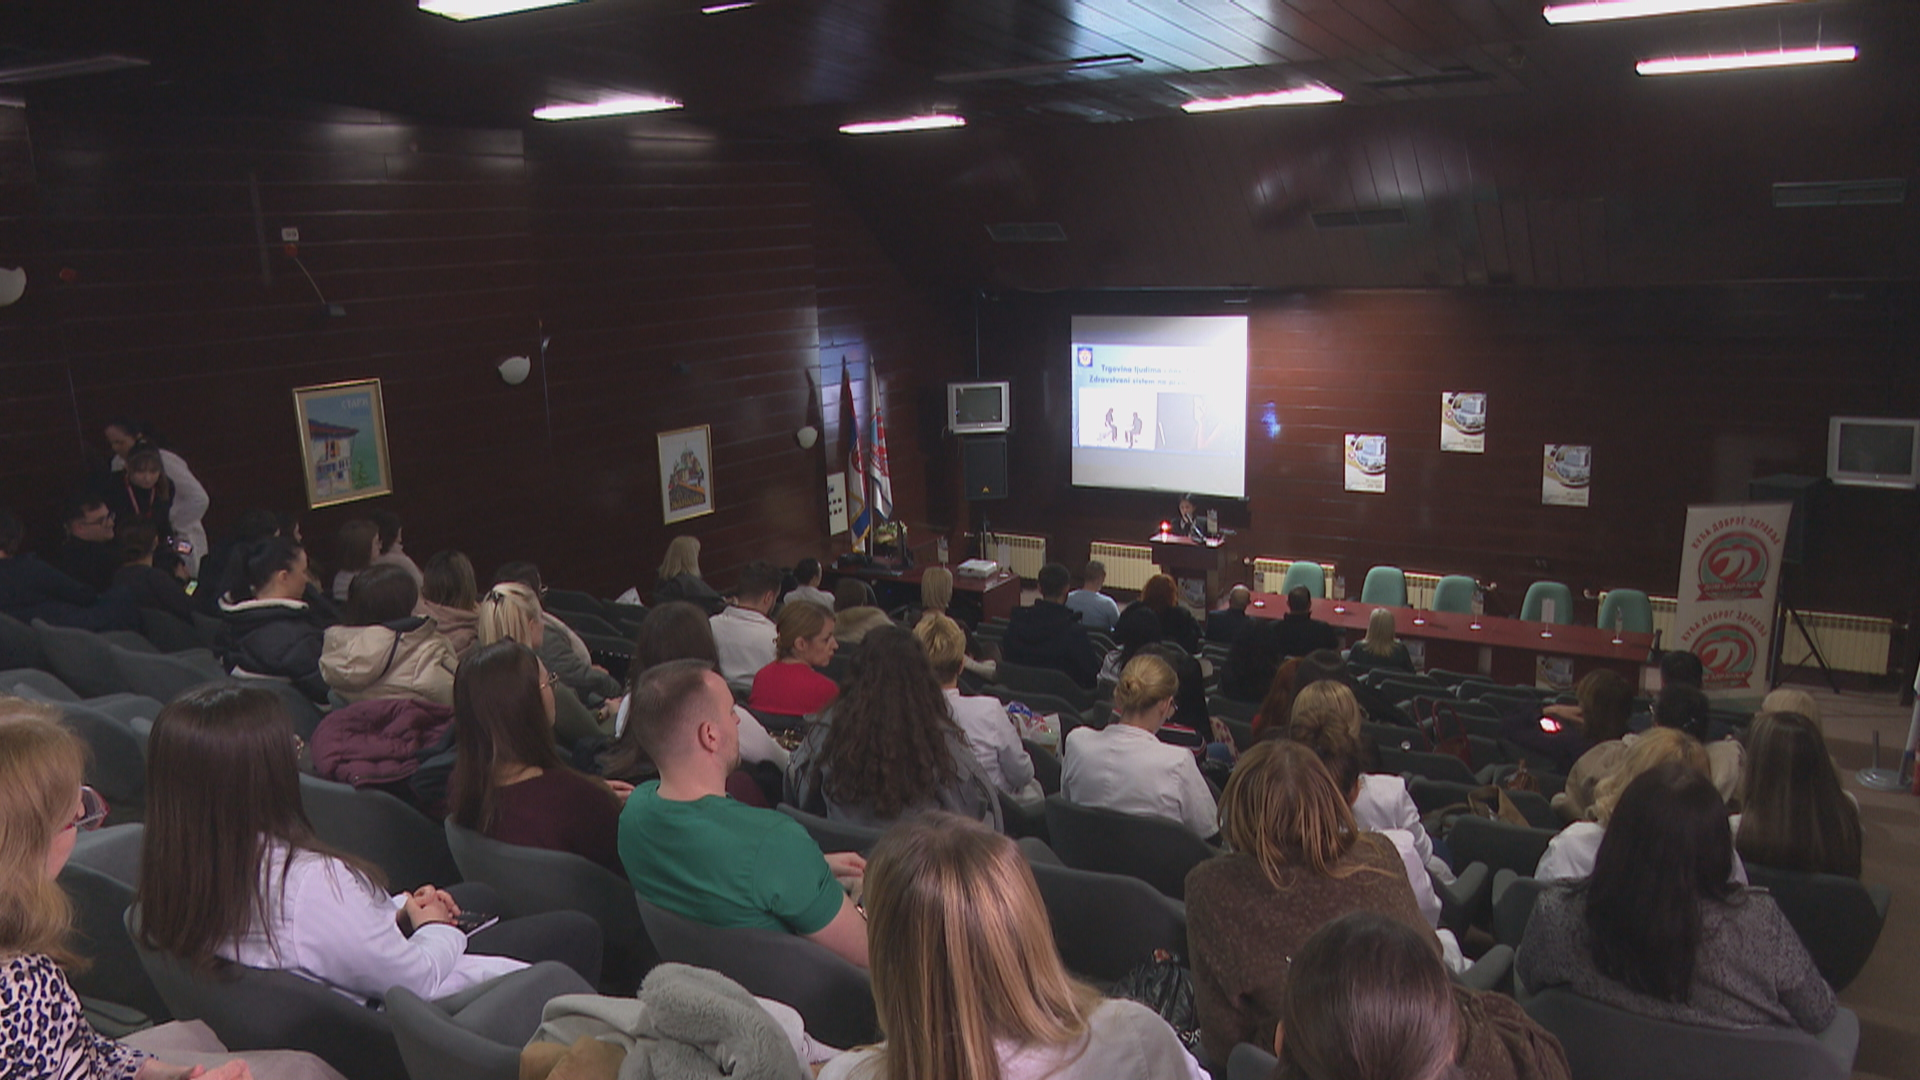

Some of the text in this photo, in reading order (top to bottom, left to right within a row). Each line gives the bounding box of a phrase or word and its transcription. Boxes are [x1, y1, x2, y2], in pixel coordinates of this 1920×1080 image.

[1089, 375, 1131, 384] Zdravstveni
[1133, 377, 1155, 385] sistem
[1101, 364, 1132, 374] Trgovina
[1134, 365, 1162, 375] ljudima
[1691, 529, 1711, 549] КУЋА
[1712, 516, 1746, 533] ДОБРОГ
[1681, 622, 1700, 642] КУЋА
[1701, 609, 1735, 626] ДОБРОГ
